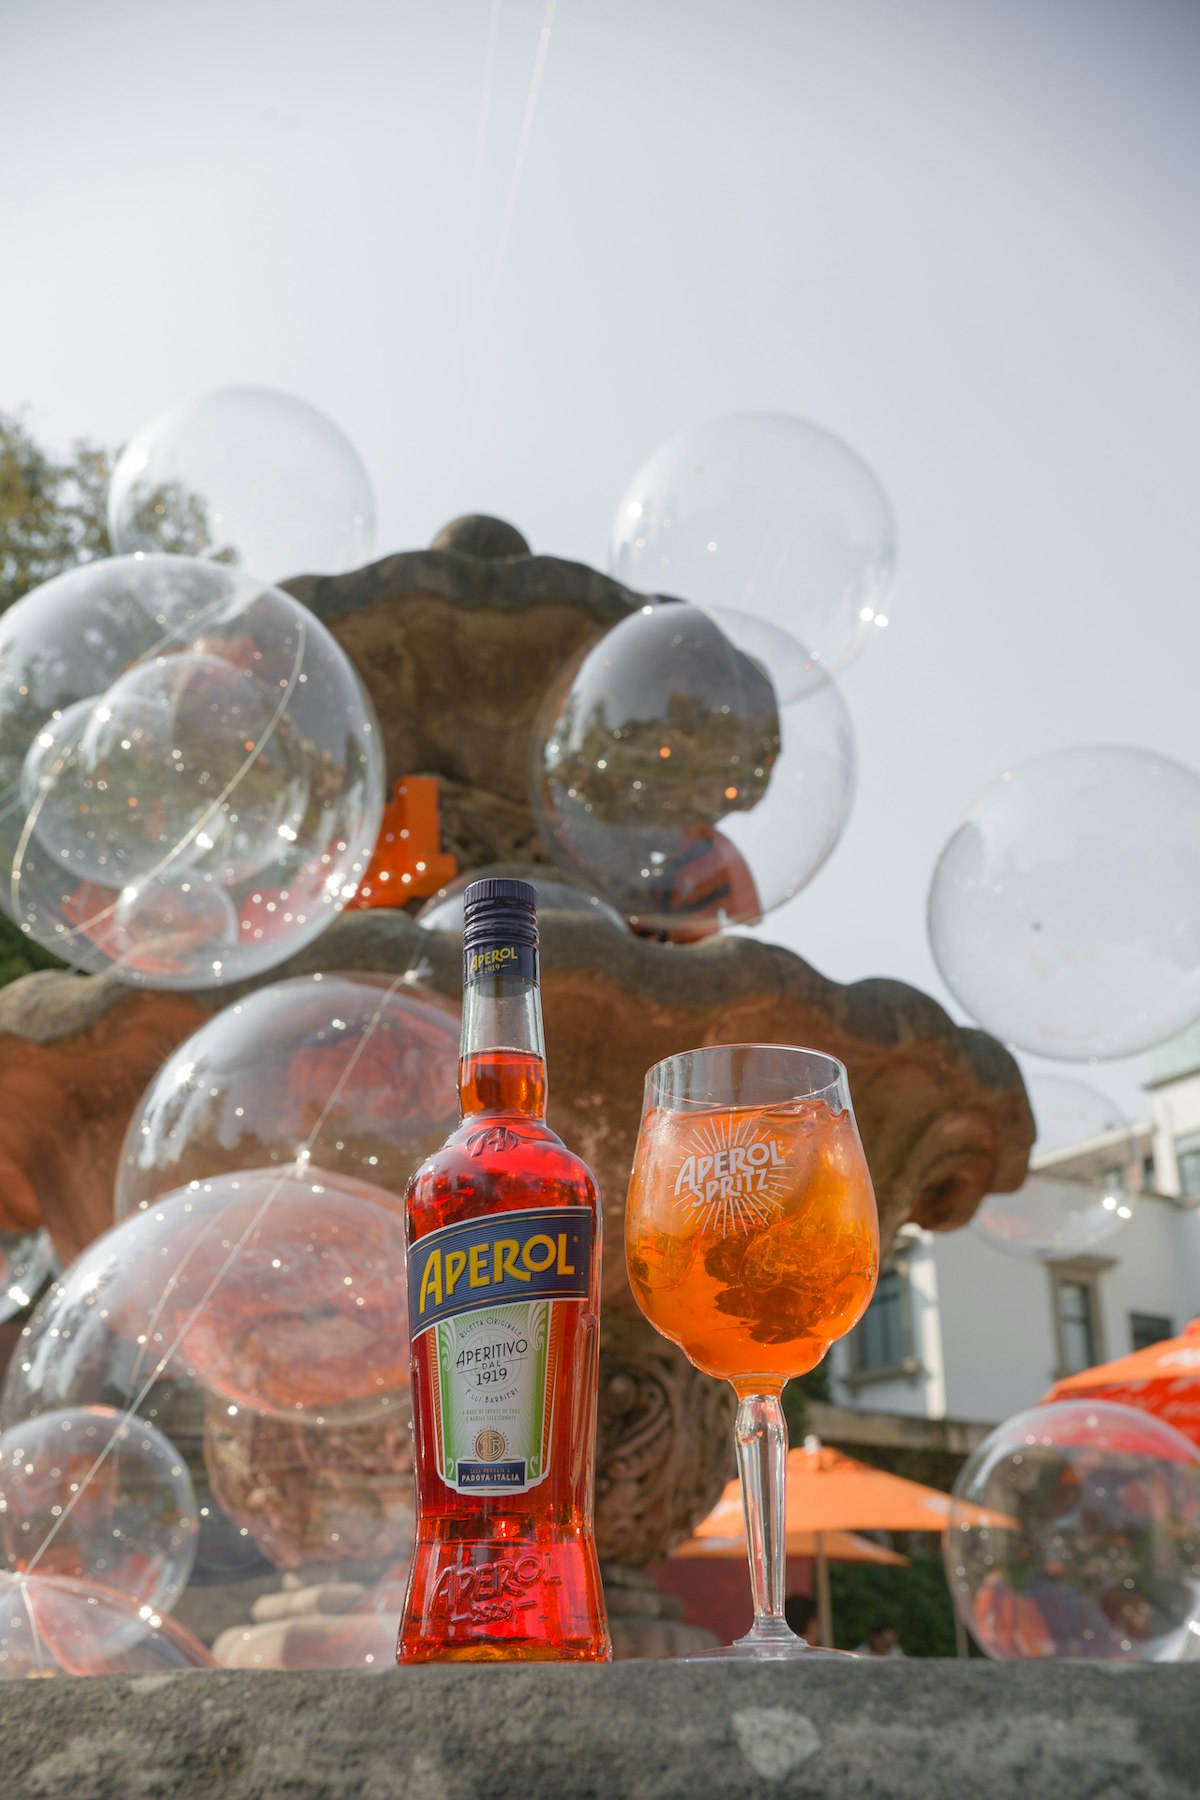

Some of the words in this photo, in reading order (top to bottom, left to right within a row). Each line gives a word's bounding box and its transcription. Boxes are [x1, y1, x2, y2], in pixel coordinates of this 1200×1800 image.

[469, 947, 518, 975] APEROL
[674, 1140, 785, 1196] APEROL
[418, 1233, 576, 1316] APEROL
[459, 1320, 484, 1339] RICETTA
[486, 1316, 523, 1338] ORIGINALE
[456, 1339, 528, 1368] APERITIVO
[481, 1360, 501, 1371] DAL
[476, 1367, 508, 1387] 1919
[485, 1387, 519, 1404] BARBIERI
